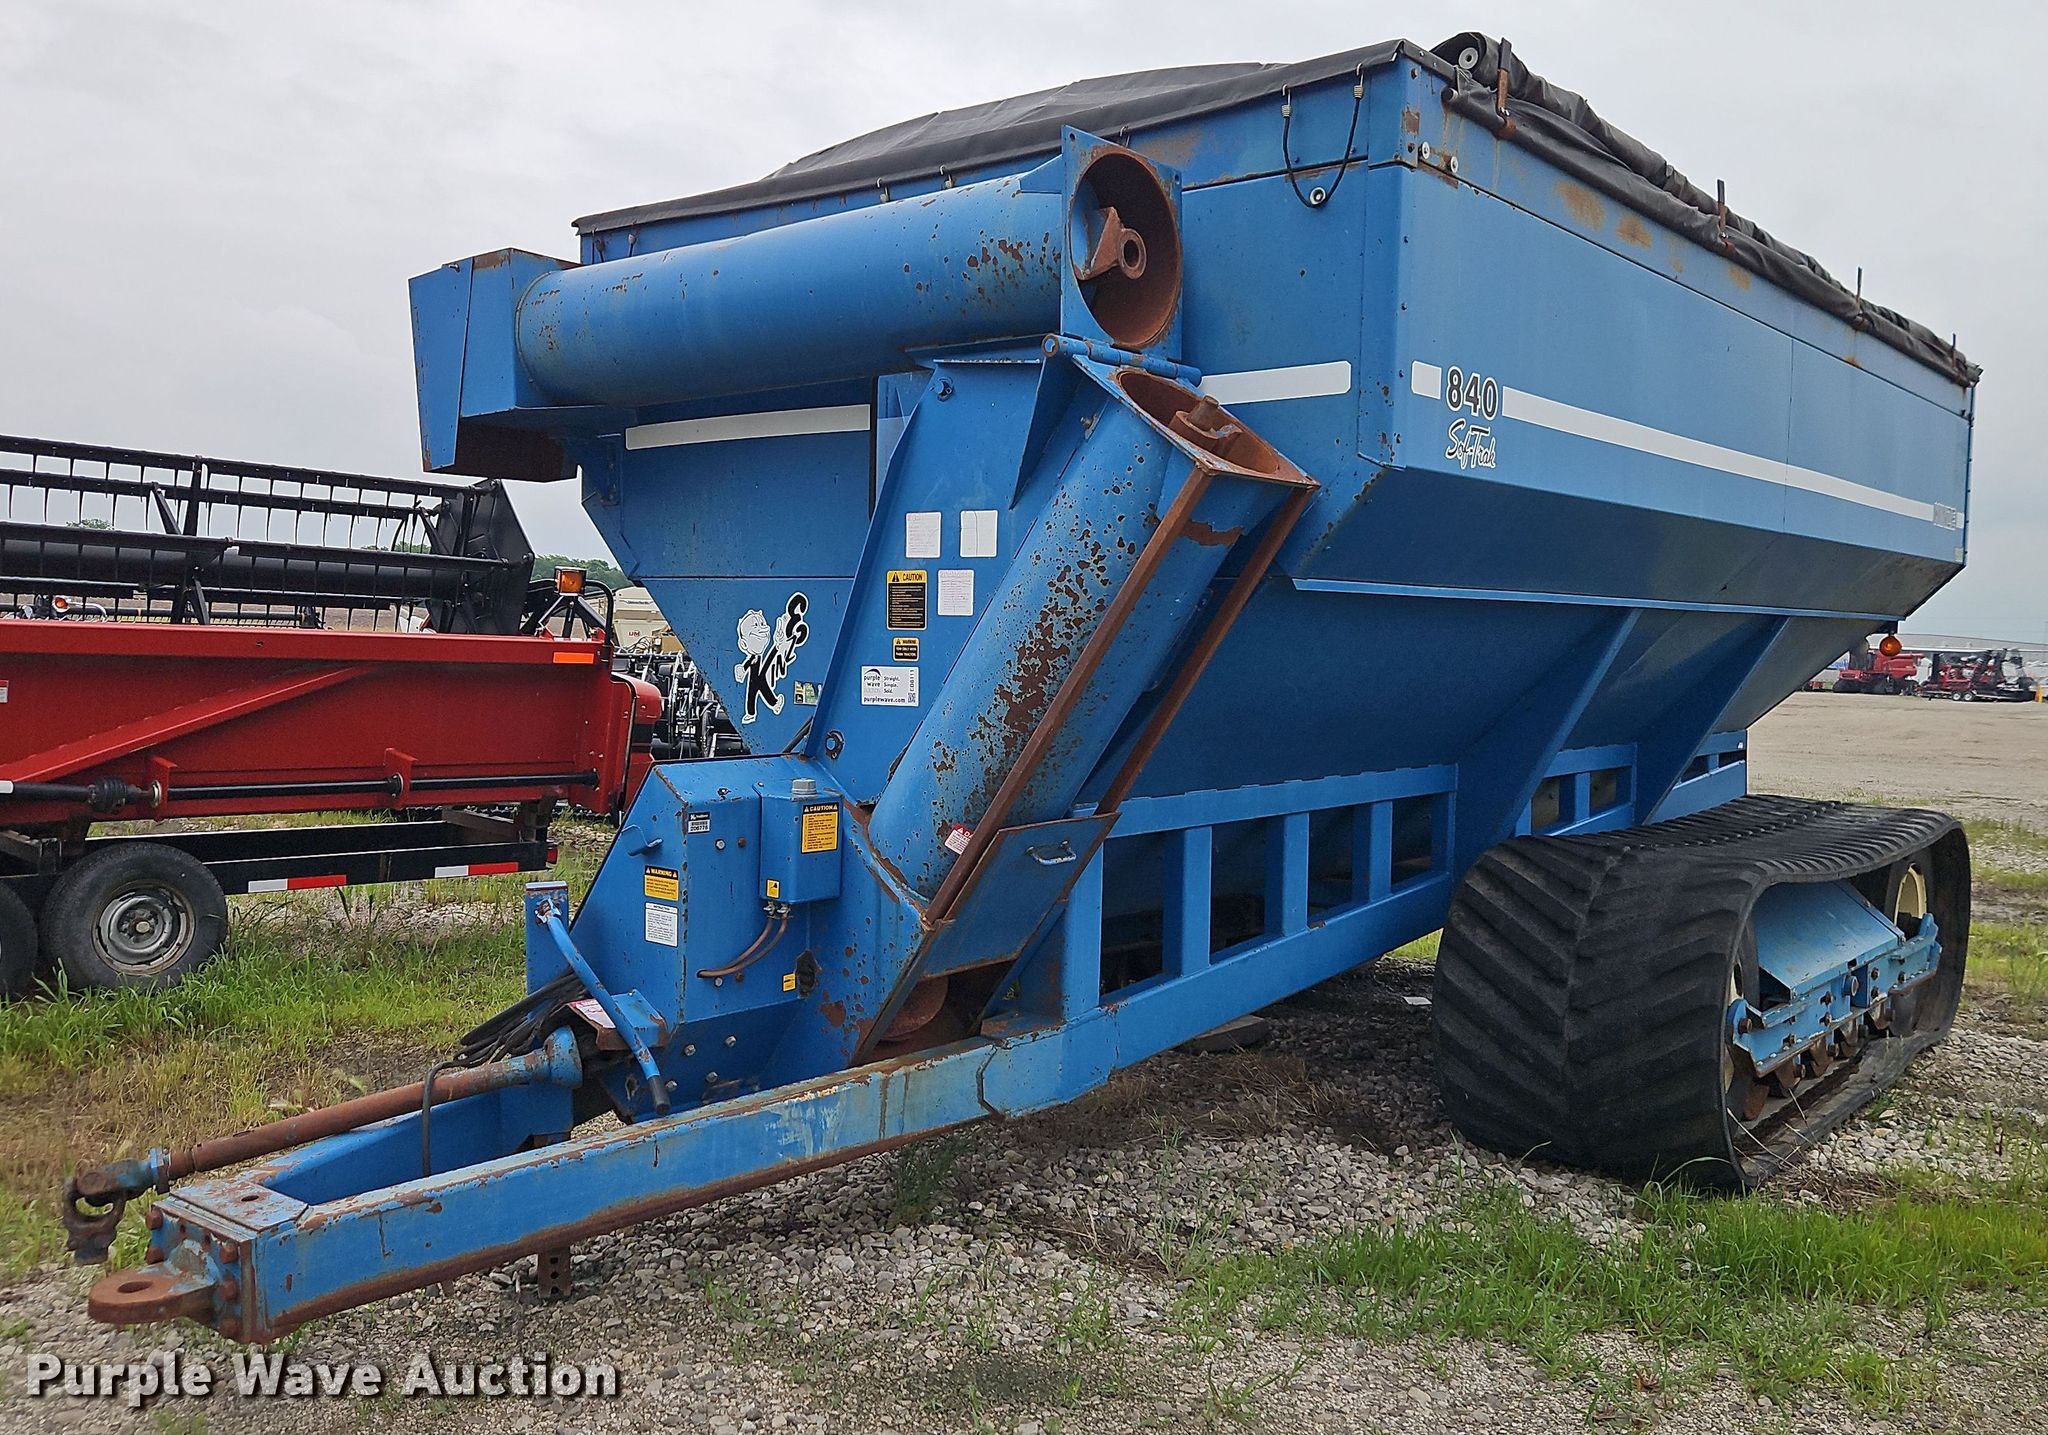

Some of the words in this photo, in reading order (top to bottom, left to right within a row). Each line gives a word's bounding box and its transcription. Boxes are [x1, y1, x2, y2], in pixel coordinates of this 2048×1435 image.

[1446, 366, 1498, 420] 840
[902, 573, 923, 581] CAUTION
[809, 804, 833, 812] CAUTION
[650, 868, 672, 877] WARNING
